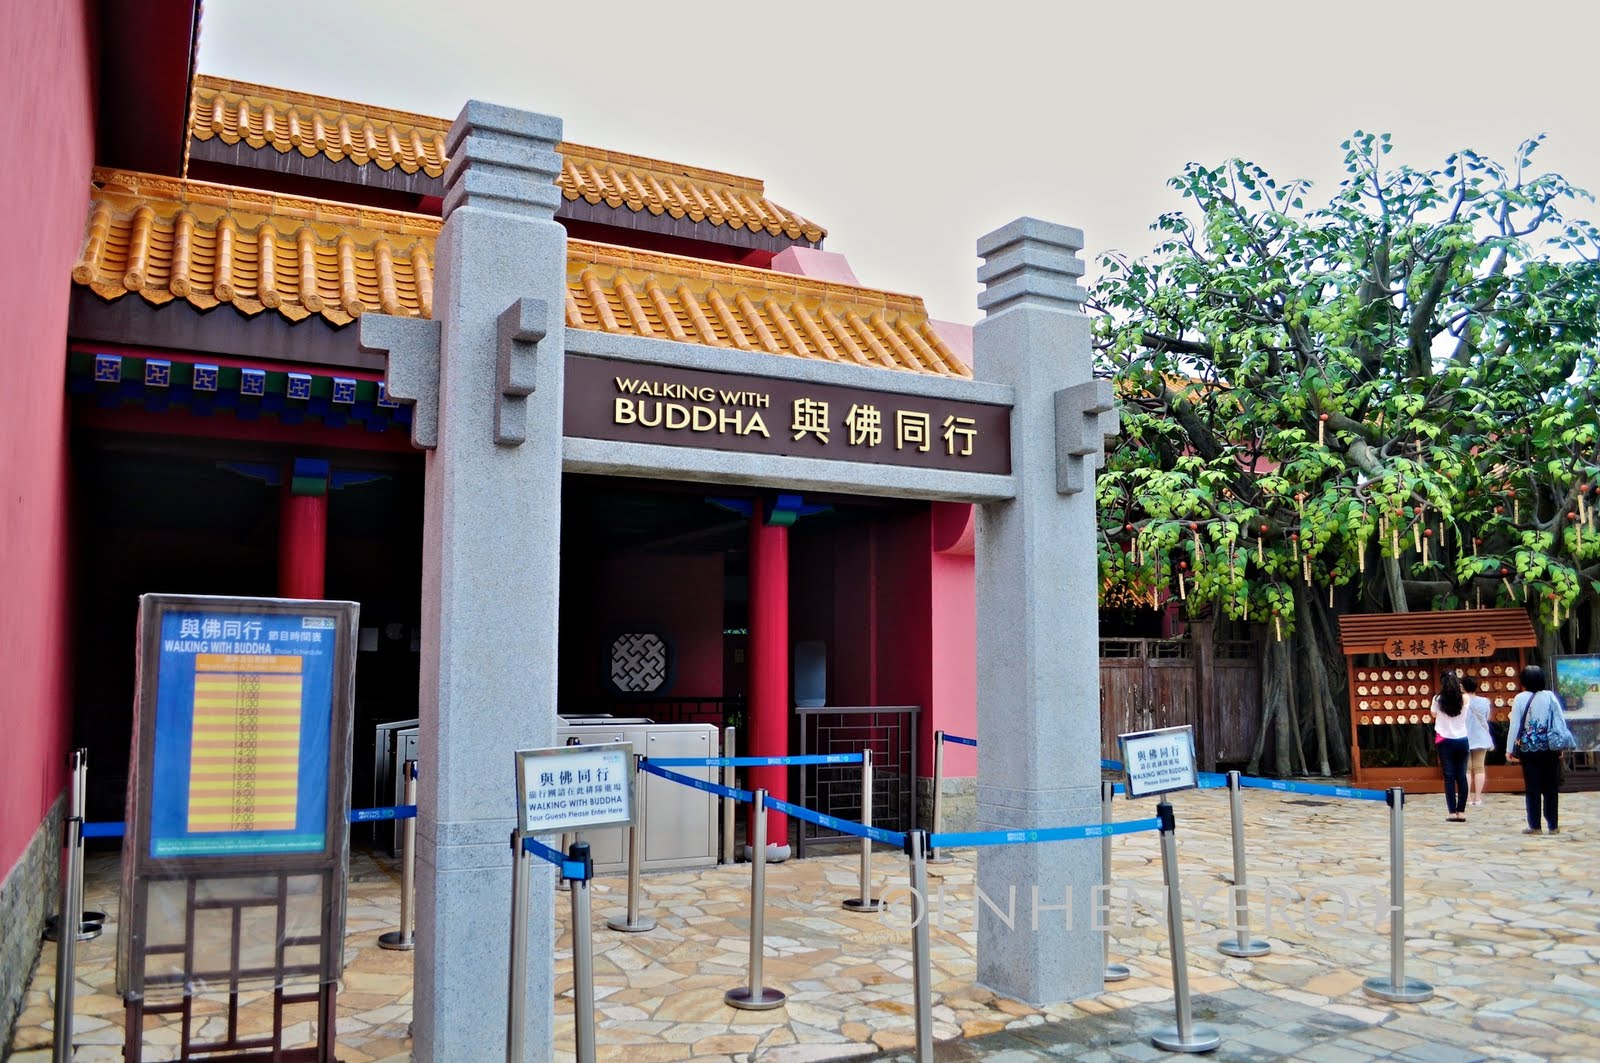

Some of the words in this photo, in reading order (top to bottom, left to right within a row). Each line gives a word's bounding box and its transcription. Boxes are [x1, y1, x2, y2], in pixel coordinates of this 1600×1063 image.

[615, 376, 715, 402] WALKING
[719, 390, 769, 408] WITH
[615, 398, 770, 438] BUDDHA
[791, 398, 977, 456] 與佛同行
[180, 618, 263, 641] 與佛同行
[268, 631, 322, 643] 節目時間表
[165, 640, 208, 653] WALKING
[211, 641, 233, 653] WITH
[234, 642, 272, 655] BUDDHA
[1391, 636, 1490, 658] 菩提許願亭
[540, 768, 609, 786] 與佛同行
[529, 800, 566, 811] WALKING
[569, 799, 588, 808] WITH
[590, 796, 622, 806] BUDDHA
[231, 814, 255, 822] 17:00
[545, 813, 567, 821] Guests
[568, 810, 589, 818] Please
[231, 822, 254, 831] 17:30
